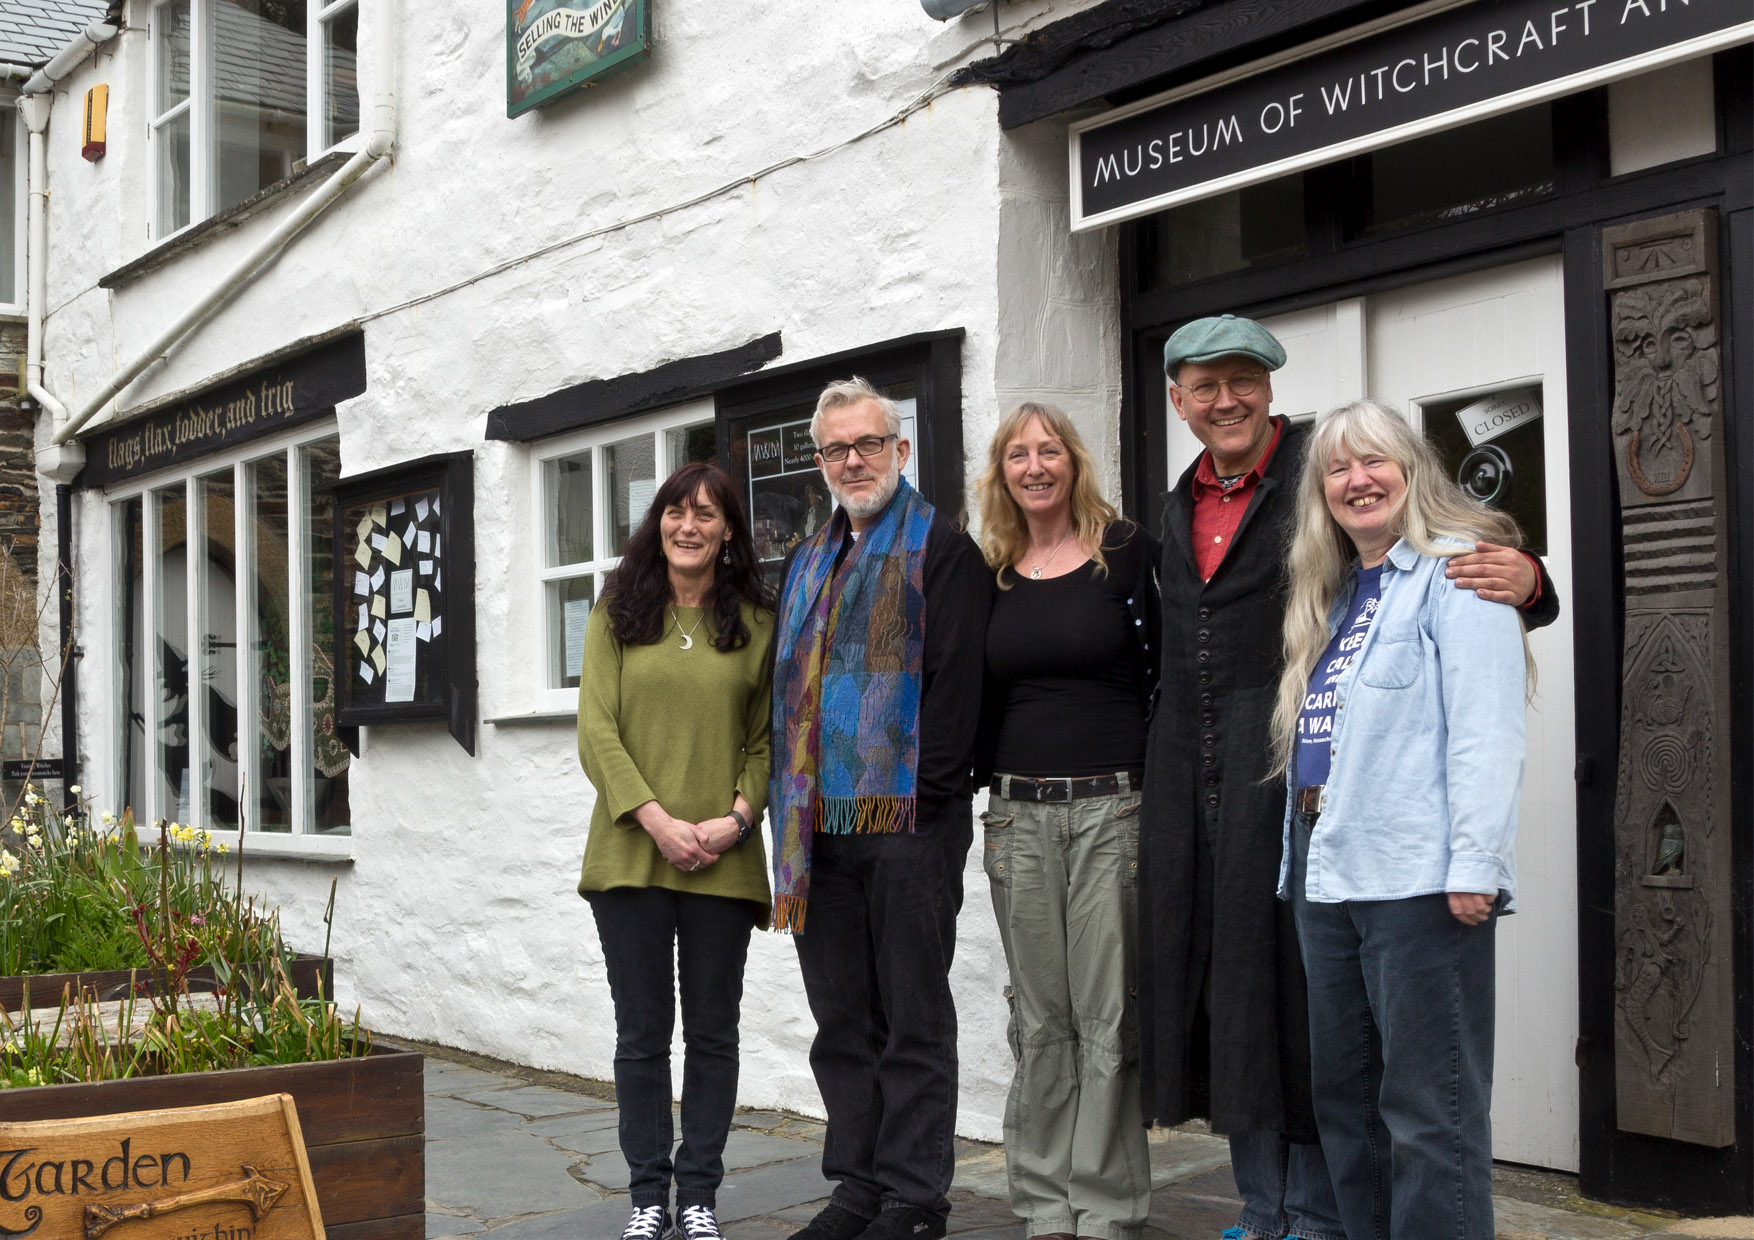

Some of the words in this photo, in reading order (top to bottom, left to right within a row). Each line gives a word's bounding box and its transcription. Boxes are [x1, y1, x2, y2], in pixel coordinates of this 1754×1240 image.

[519, 11, 562, 59] SELLING
[565, 14, 585, 33] THE
[1093, 115, 1243, 188] MUSEUM
[1260, 93, 1304, 135] OF
[1320, 0, 1597, 116] WITCHCRAFT
[1474, 402, 1530, 436] CLOSED
[1339, 632, 1366, 652] KEE
[1326, 655, 1352, 674] CAL
[1305, 690, 1337, 711] CAR
[1309, 715, 1332, 735] WA
[0, 1137, 191, 1203] Garden
